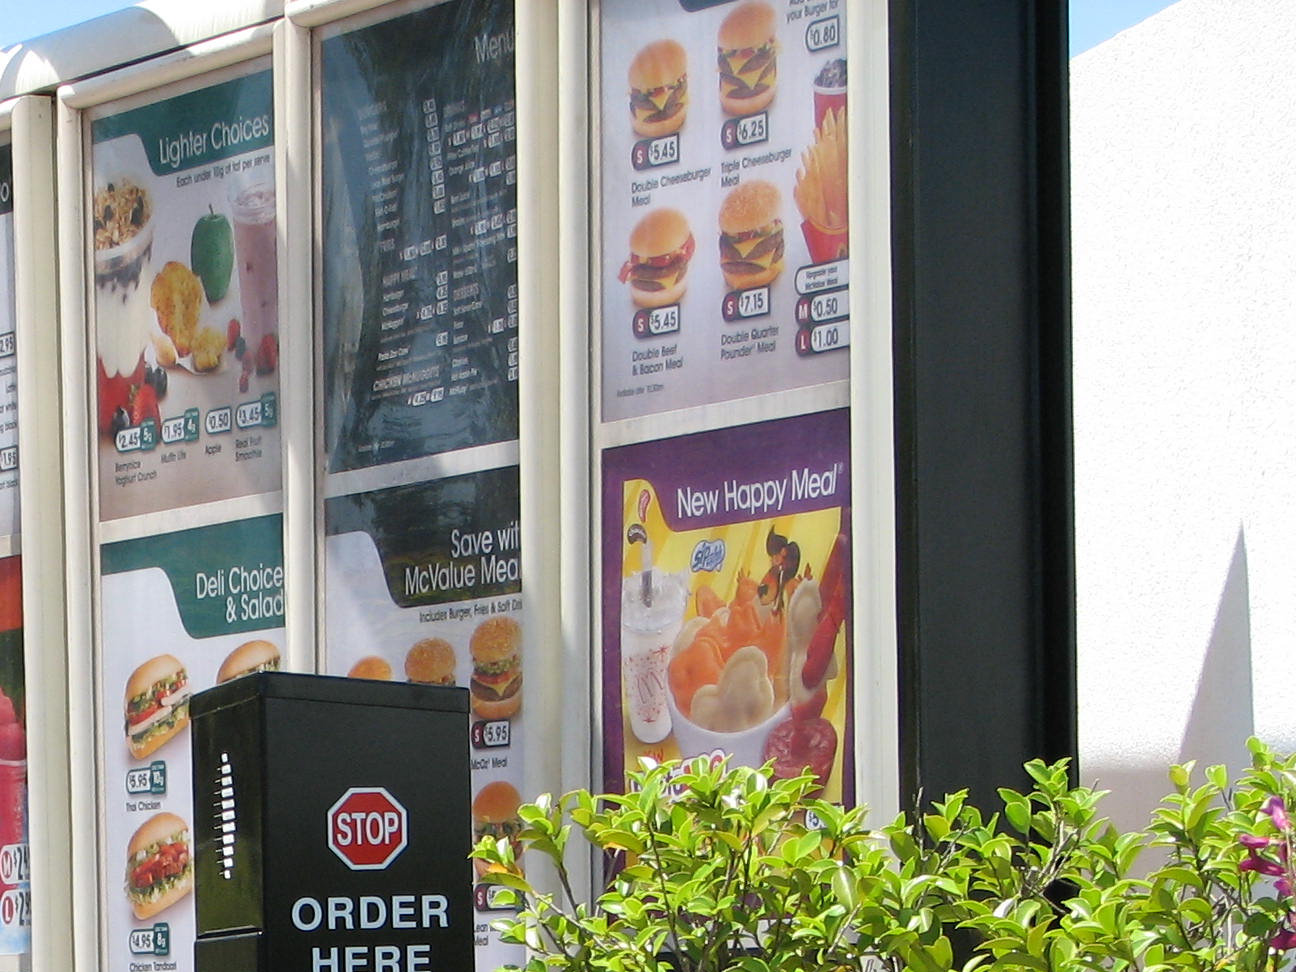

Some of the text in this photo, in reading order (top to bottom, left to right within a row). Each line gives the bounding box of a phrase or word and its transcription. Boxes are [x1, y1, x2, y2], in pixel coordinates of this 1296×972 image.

[474, 29, 515, 64] Menu
[159, 114, 270, 169] Lighter Choices
[726, 119, 764, 142] S $6.25
[636, 151, 643, 164] S
[721, 148, 792, 174] Triple Cheeseburger
[176, 175, 192, 188] Each
[632, 167, 711, 194] Double Cheeseburger
[721, 174, 740, 188] Meal
[632, 193, 650, 207] Meal
[727, 295, 764, 315] S $7.15
[799, 298, 838, 320] M $0.50
[637, 311, 676, 332] S $5.45
[721, 325, 779, 346] Double Quarter
[757, 340, 776, 353] Meal
[800, 327, 838, 350] L $1.00
[632, 344, 678, 362] Double Beef
[639, 361, 664, 375] Bacon
[665, 356, 684, 370] Meal
[677, 486, 719, 518] New
[724, 477, 787, 512] Happy
[791, 464, 838, 499] Meal
[451, 528, 493, 559] Save
[196, 562, 283, 599] Deli Choice
[405, 554, 519, 596] McValue Mea
[226, 588, 283, 624] & Salad
[419, 609, 448, 624] Includes
[474, 603, 489, 616] Fries
[497, 599, 511, 612] Soft
[474, 725, 508, 743] S $5.95
[336, 812, 399, 846] STOP
[477, 891, 483, 906] S
[291, 895, 449, 931] ORDER
